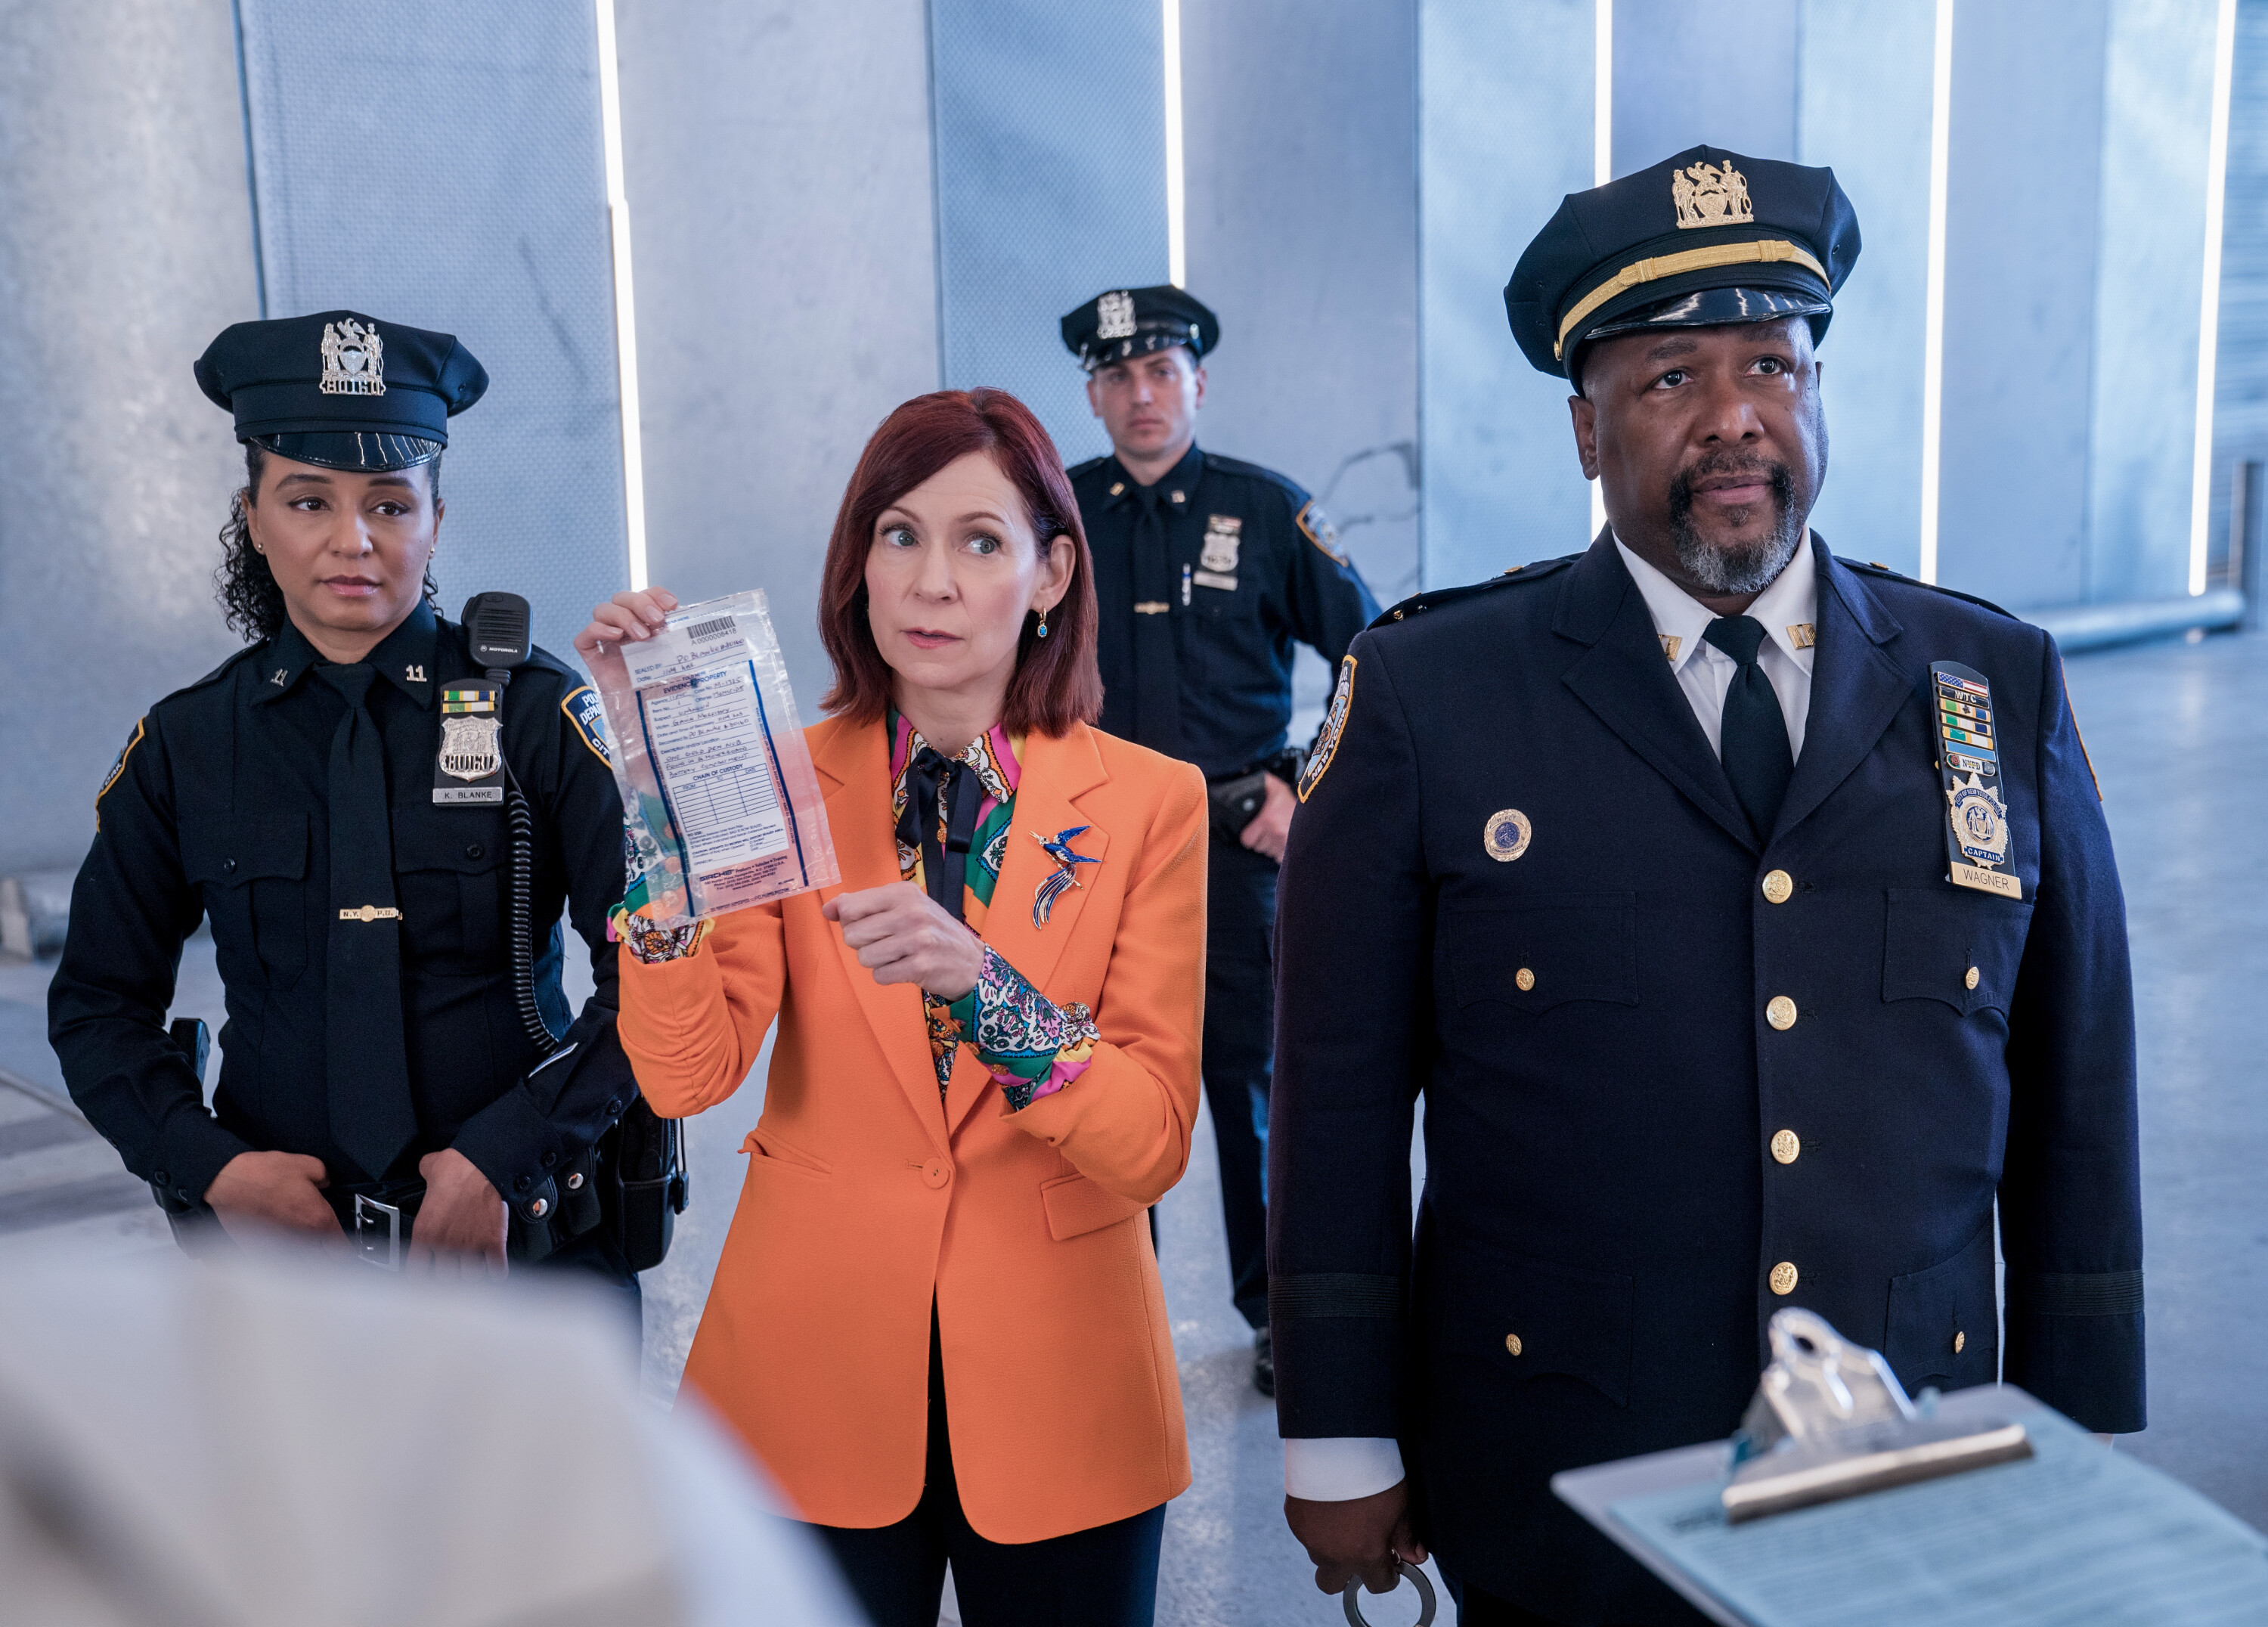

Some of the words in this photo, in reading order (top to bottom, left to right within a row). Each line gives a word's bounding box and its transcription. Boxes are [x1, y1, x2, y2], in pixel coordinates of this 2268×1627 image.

[405, 664, 427, 682] 11
[634, 665, 654, 674] SEALED
[270, 668, 289, 687] 11
[637, 674, 652, 683] Date:
[651, 697, 668, 706] Agency
[695, 694, 711, 702] Offense
[1955, 690, 1976, 703] WTC
[653, 713, 671, 722] Suspect
[694, 720, 714, 729] Recovery
[592, 738, 610, 756] CIT
[658, 736, 683, 746] Recovered
[661, 744, 685, 755] Description
[685, 741, 701, 749] and/or
[700, 736, 720, 745] Location
[1312, 751, 1329, 782] NEW
[1328, 708, 1346, 749] YORK
[448, 755, 491, 773] 80160
[1963, 759, 1981, 770] NYPD
[692, 771, 710, 781] CHAIN
[719, 763, 743, 773] CUSTODY
[457, 791, 492, 800] BLANKE
[1955, 792, 1963, 803] CITY
[1977, 790, 1988, 799] YORK
[1988, 798, 2002, 815] POLICE
[1968, 848, 2000, 862] CAPTAIN
[699, 868, 733, 882] SIRCHIE
[735, 865, 751, 873] Products
[1963, 869, 2009, 891] WAGNER
